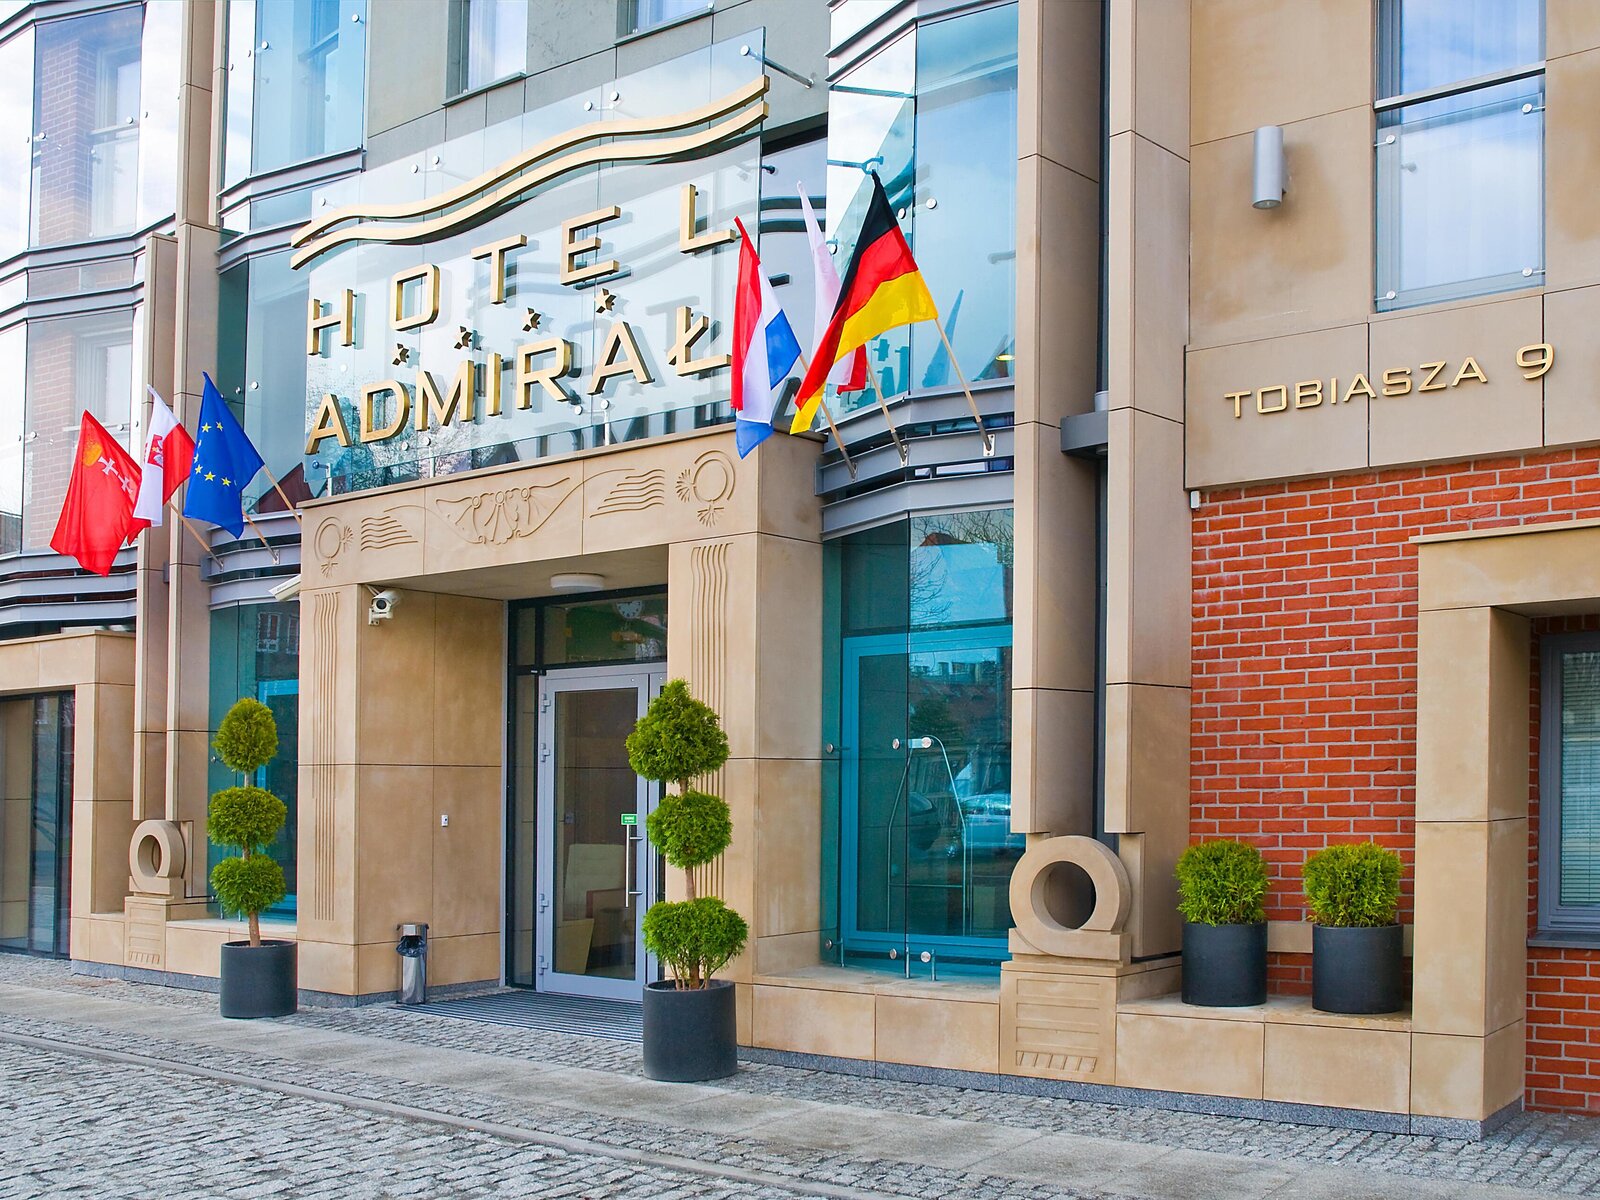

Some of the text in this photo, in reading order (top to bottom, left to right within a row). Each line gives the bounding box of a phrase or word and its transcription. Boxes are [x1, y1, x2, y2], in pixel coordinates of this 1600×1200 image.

[307, 183, 737, 356] HOTEL
[304, 306, 732, 455] ADMIRAŁ
[1223, 343, 1555, 418] TOBIASZA 9
